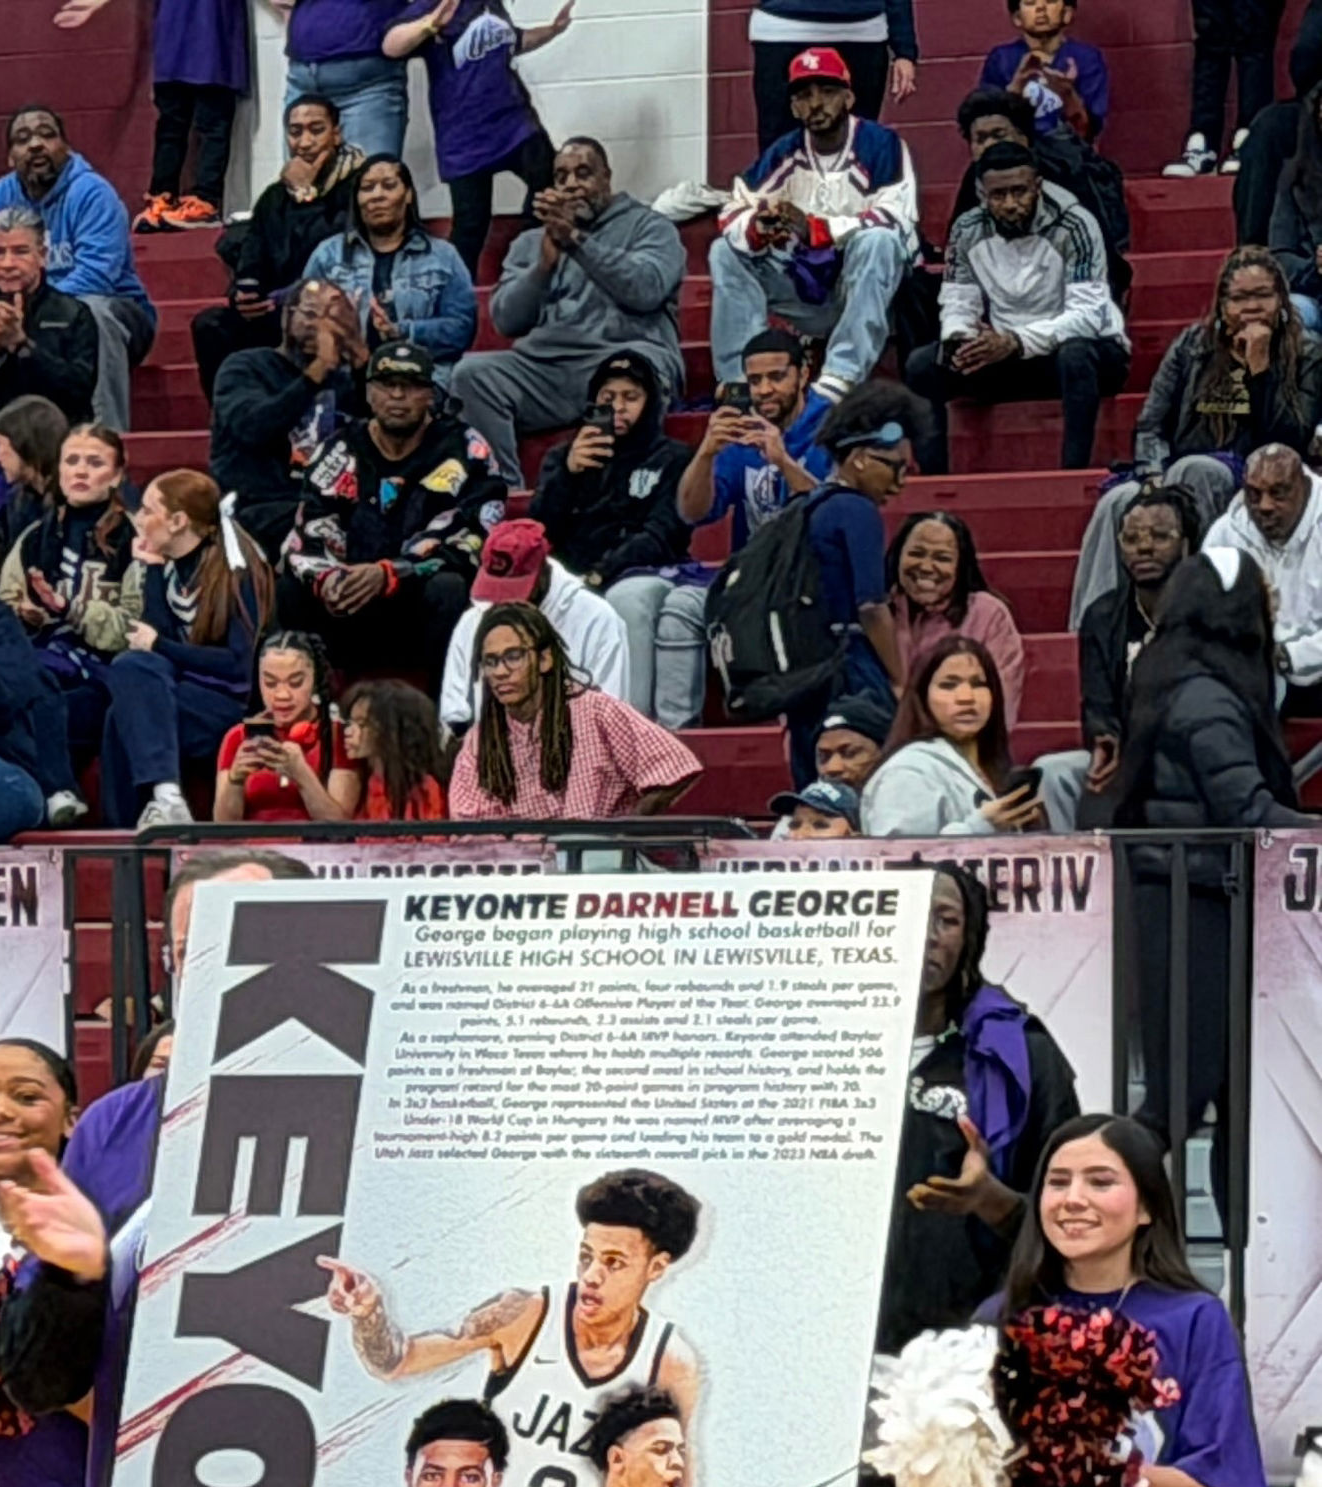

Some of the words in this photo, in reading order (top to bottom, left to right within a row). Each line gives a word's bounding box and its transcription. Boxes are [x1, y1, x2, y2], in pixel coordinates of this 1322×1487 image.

[1051, 855, 1096, 913] IV
[404, 893, 569, 921] KEYONTE
[575, 892, 740, 918] DARNELL
[748, 889, 899, 917] GEORGE
[415, 924, 486, 948] George
[493, 924, 552, 946] began
[560, 924, 631, 944] playing
[639, 922, 682, 944] high
[689, 920, 751, 940] school
[758, 919, 860, 938] basketball
[867, 920, 897, 938] for
[404, 950, 513, 967] LEWISVILLE
[517, 949, 574, 966] HIGH
[578, 948, 667, 966] SCHOOL
[671, 948, 698, 964] IN
[701, 948, 825, 967] LEWISVILLE,
[830, 947, 898, 964] TEXAS.
[513, 1393, 597, 1457] JAZ
